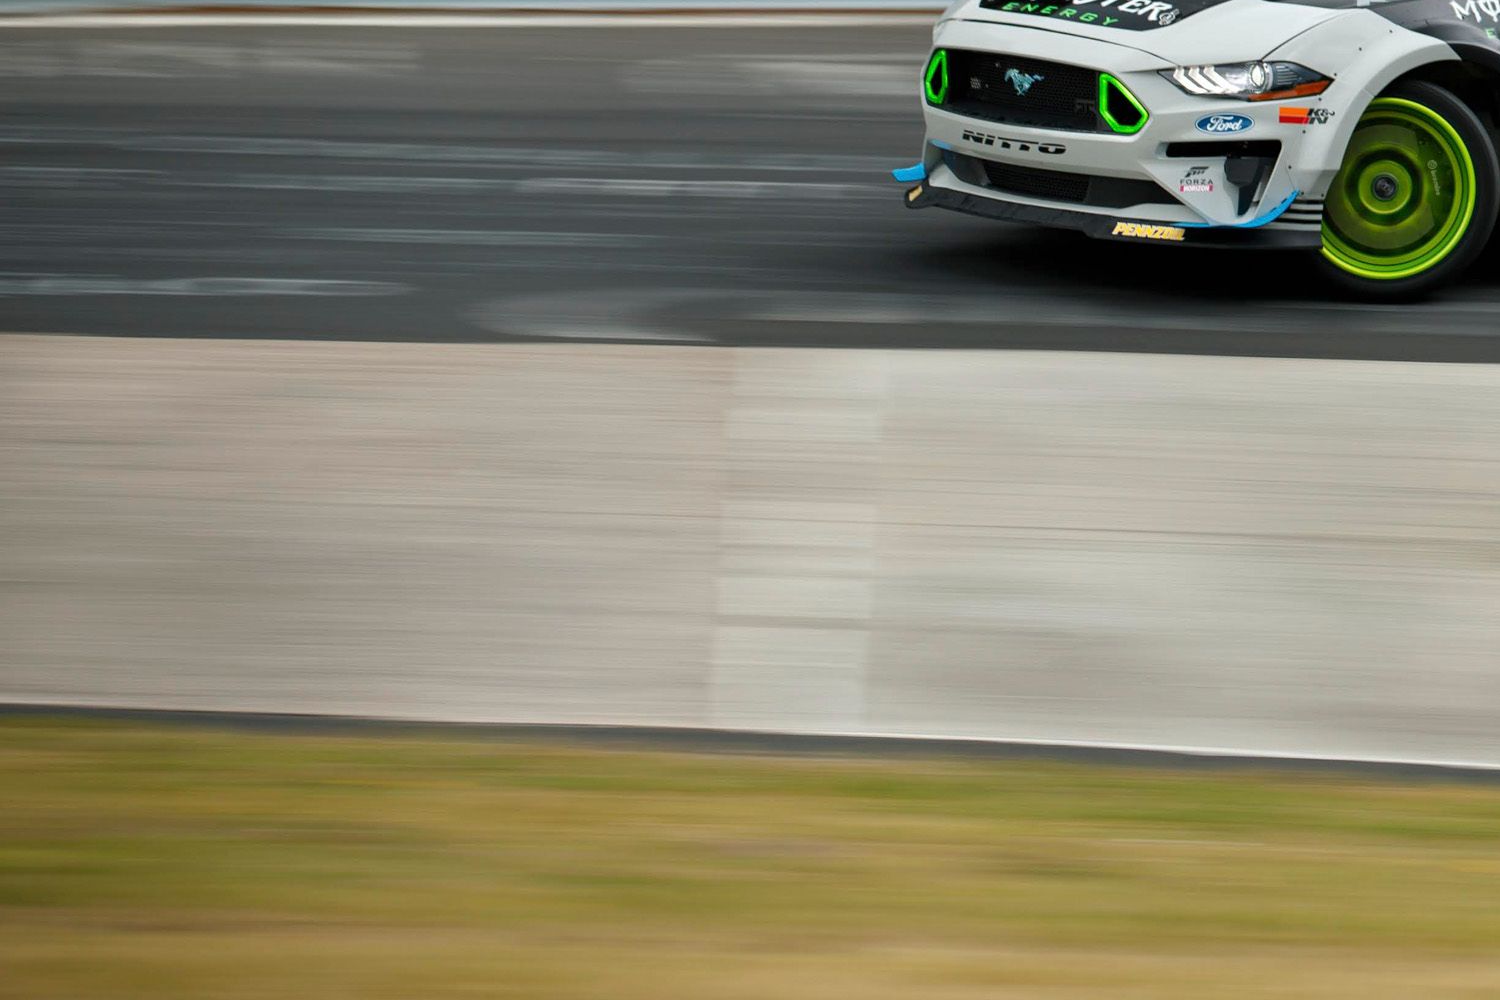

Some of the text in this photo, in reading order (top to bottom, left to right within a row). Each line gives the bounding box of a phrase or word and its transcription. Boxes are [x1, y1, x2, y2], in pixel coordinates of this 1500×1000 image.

[1001, 1, 1120, 26] ENERGY
[1206, 114, 1244, 132] Ford
[962, 129, 1067, 155] NITTO
[1112, 221, 1185, 241] PENNZOIL
